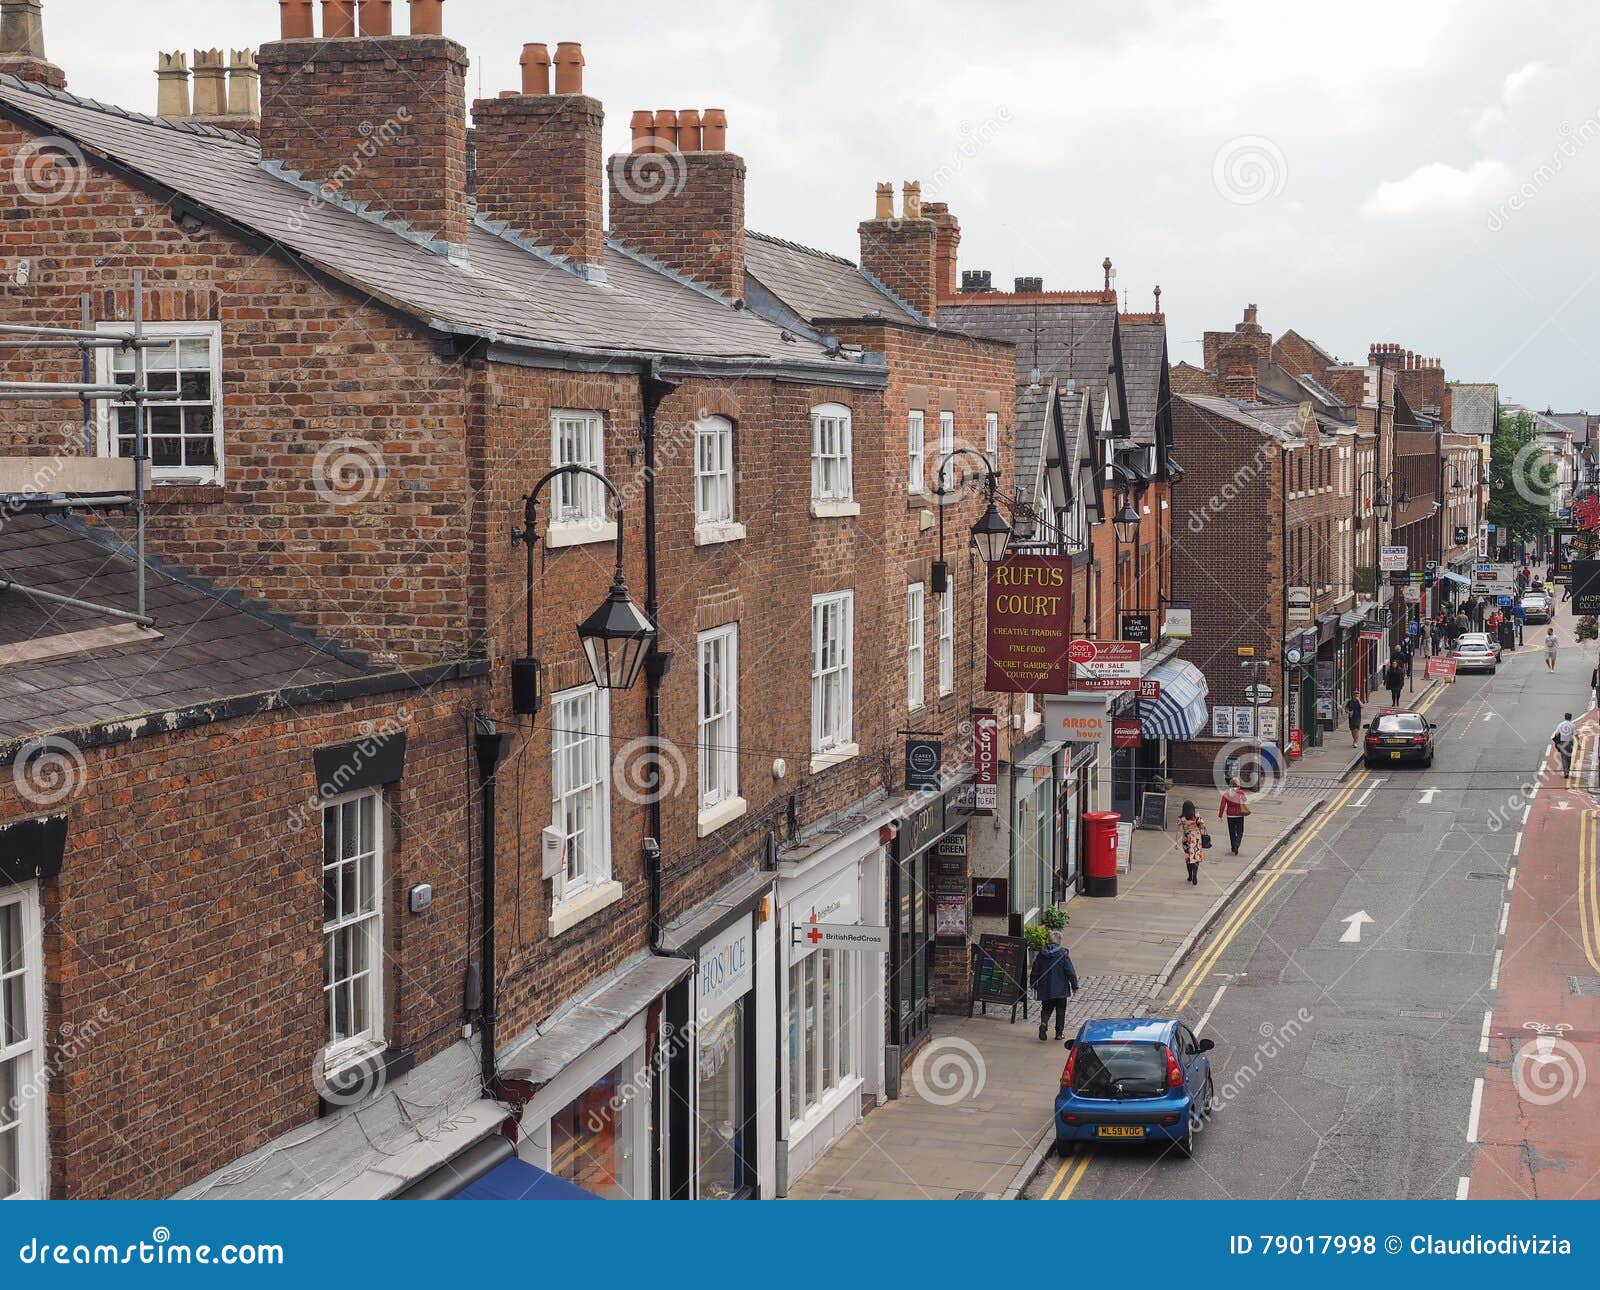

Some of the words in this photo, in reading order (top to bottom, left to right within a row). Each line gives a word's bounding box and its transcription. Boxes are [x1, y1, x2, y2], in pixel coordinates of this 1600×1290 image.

[996, 566, 1064, 587] RUFUS
[996, 595, 1062, 616] COURT
[993, 628, 1029, 636] CREATIVE
[1030, 629, 1062, 637] TRADING
[1009, 645, 1026, 653] FINE
[1072, 644, 1090, 652] POST
[994, 661, 1021, 669] SECRET
[1023, 662, 1052, 670] GARDEN
[1054, 662, 1061, 670] &
[1006, 671, 1048, 680] COURTYARD
[1062, 717, 1103, 729] ARBOL
[1076, 729, 1103, 738] house
[980, 732, 992, 781] SHOPS
[940, 836, 965, 844] ABBEY
[940, 844, 965, 854] GREEN
